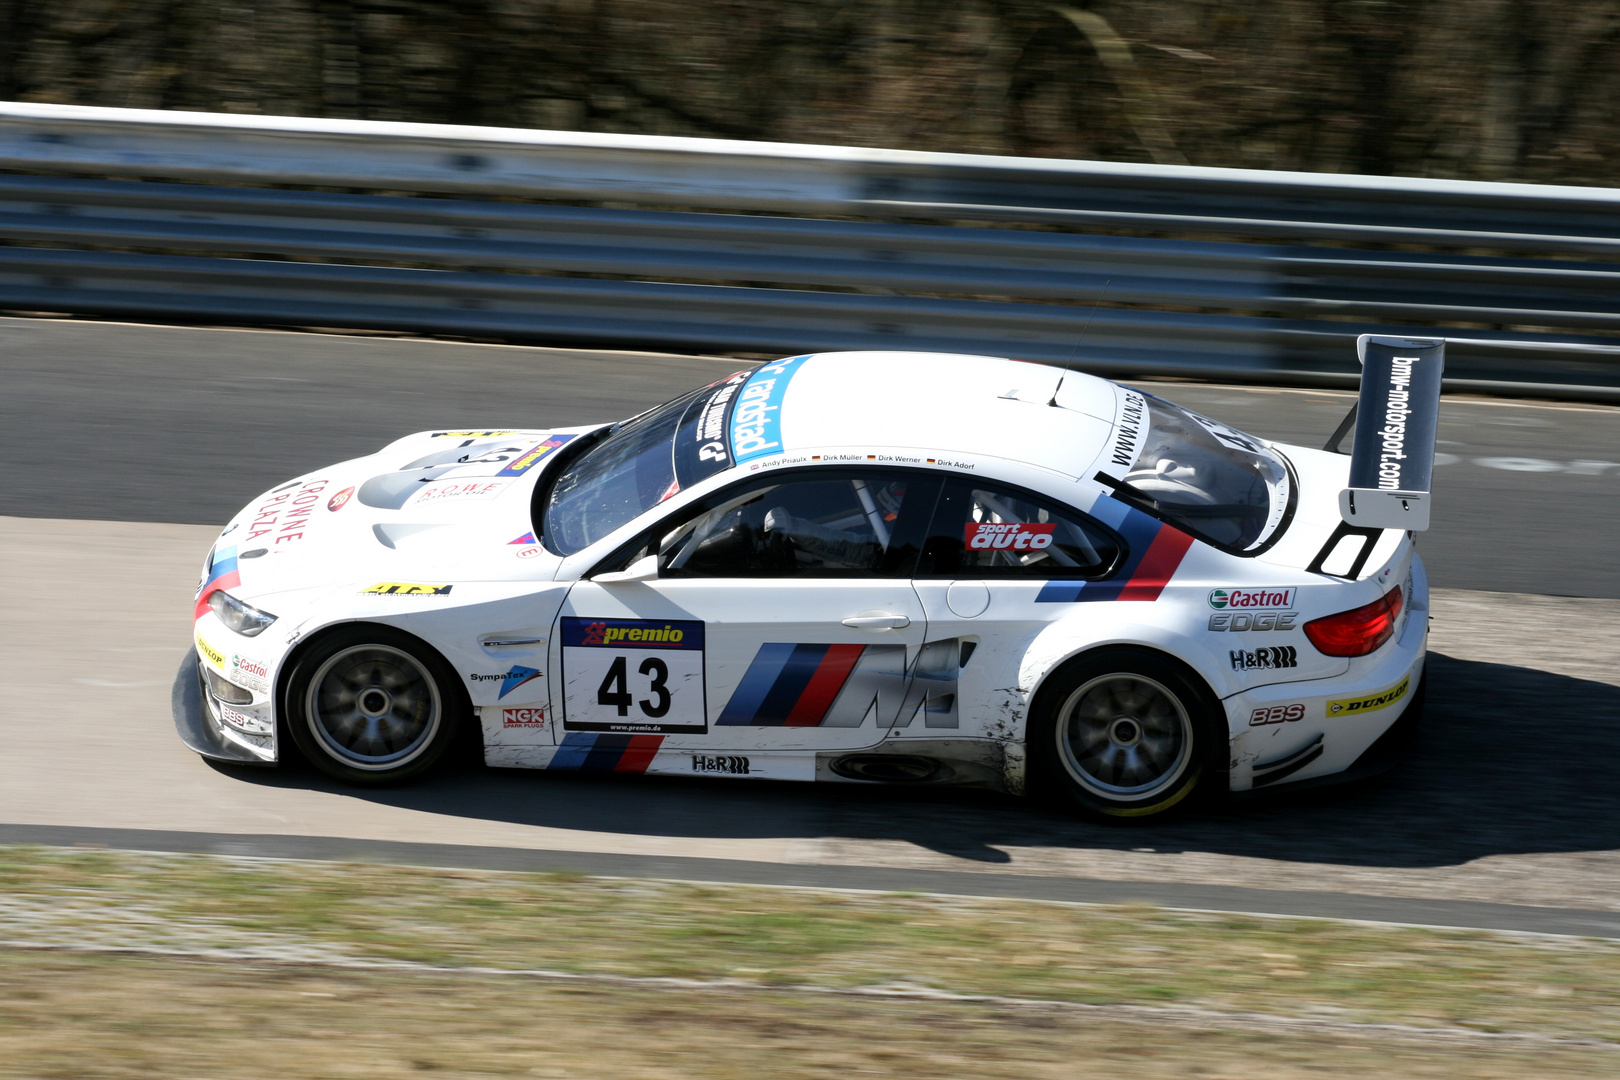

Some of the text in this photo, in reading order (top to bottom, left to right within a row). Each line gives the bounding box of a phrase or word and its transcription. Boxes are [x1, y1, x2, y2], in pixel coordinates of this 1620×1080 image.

[734, 378, 779, 457] randstad
[1378, 357, 1420, 490] bmw-motorsport.com
[1112, 393, 1144, 467] WWW.VLN.DE
[762, 456, 807, 469] Andy Priaulx
[840, 453, 863, 461] Müller
[878, 454, 921, 464] Dirk Werner
[938, 459, 975, 470] Dirk Adorf
[421, 482, 502, 499] ROWE
[245, 493, 291, 541] PLAZA
[275, 480, 329, 544] CROWNE
[976, 523, 1021, 535] sport
[970, 531, 1053, 549] auto
[1230, 589, 1290, 608] Castrol
[1208, 611, 1300, 632] EDGE
[603, 625, 683, 645] premio
[198, 638, 223, 663] DUNLOP
[1229, 646, 1274, 671] H&R
[240, 658, 268, 679] Castrol
[230, 668, 270, 695] EDGE
[597, 656, 672, 718] 43
[1346, 680, 1410, 711] DUNLOP
[223, 707, 245, 727] BBS
[503, 709, 544, 723] NGK
[1249, 704, 1305, 727] BBS
[610, 724, 662, 732] www.premio.de
[692, 755, 730, 773] H&R
